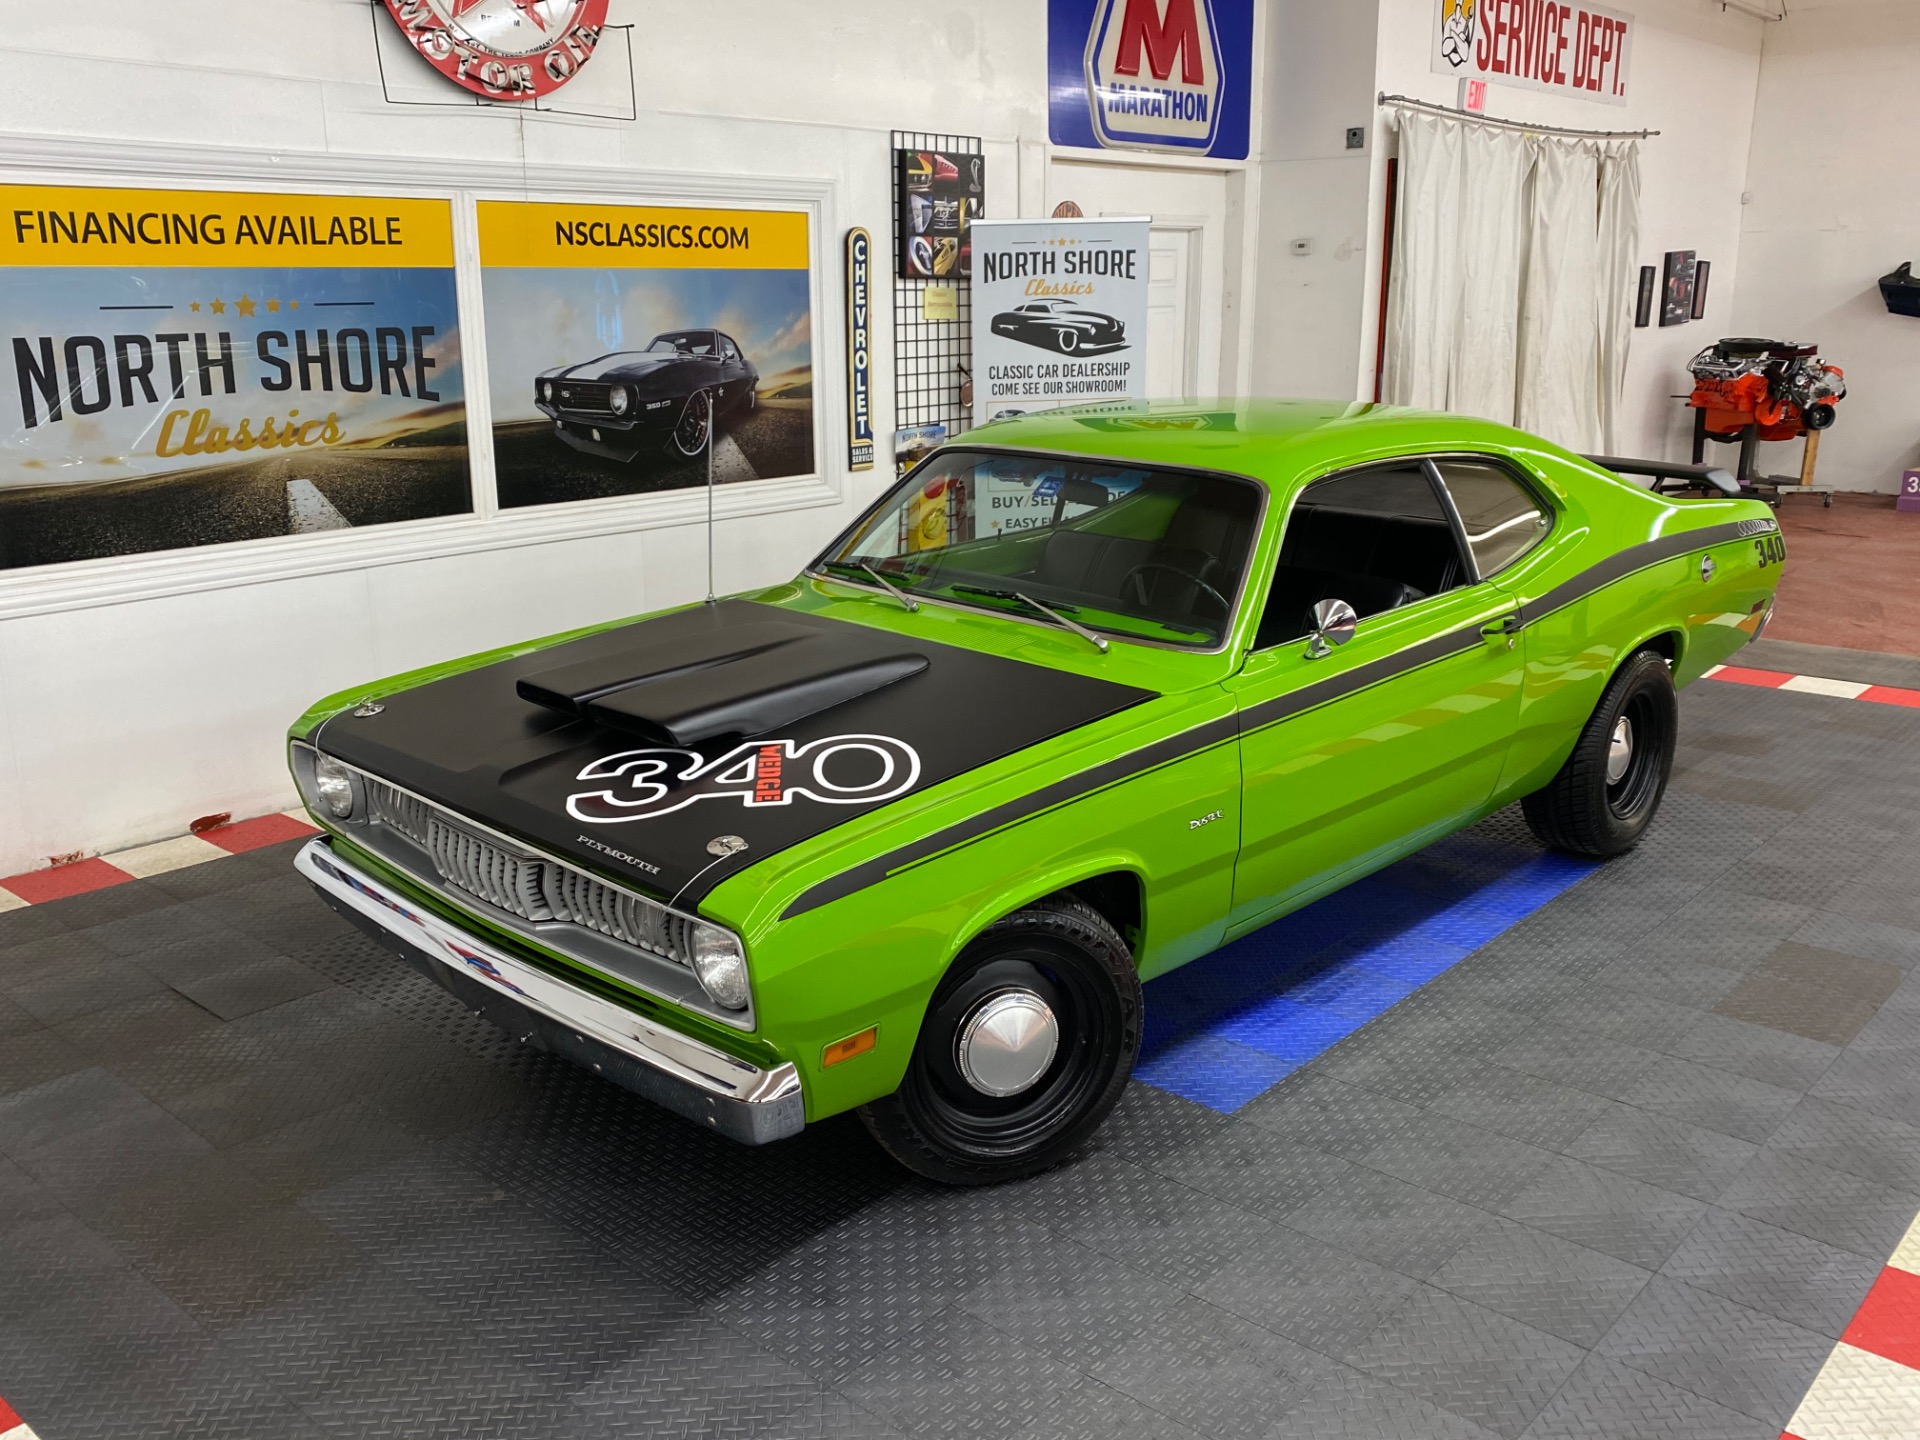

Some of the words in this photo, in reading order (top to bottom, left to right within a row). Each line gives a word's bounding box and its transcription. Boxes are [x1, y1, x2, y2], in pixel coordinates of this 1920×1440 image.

[544, 24, 602, 83] OIL
[1113, 0, 1204, 86] M
[1476, 0, 1571, 85] SERVICE
[1572, 10, 1628, 96] DEPT.
[1108, 82, 1208, 122] MARATHON
[13, 210, 226, 245] FINANCING
[235, 215, 403, 245] AVAILABLE
[555, 221, 749, 249] NSCLASSICS.COM
[984, 250, 1056, 283] NORTH
[1064, 249, 1136, 280] SHORE
[1024, 278, 1095, 296] Classics
[854, 240, 868, 435] CHEVROLET
[12, 331, 236, 429] NORTH
[256, 325, 440, 402] SHORE
[989, 365, 1033, 380] CLASSIC
[1037, 364, 1059, 378] CAR
[1063, 362, 1130, 377] DEALERSHIP
[992, 383, 1019, 395] COME
[1022, 382, 1040, 395] SEE
[1043, 381, 1063, 394] OUR
[1066, 379, 1127, 393] SHOWROOM!
[155, 408, 346, 459] Classics
[852, 448, 868, 456] SALES
[1006, 518, 1038, 528] EASY
[1755, 536, 1786, 568] 340
[566, 733, 921, 823] 340
[755, 744, 782, 802] WEDGE
[576, 834, 661, 876] PLYMOUTH
